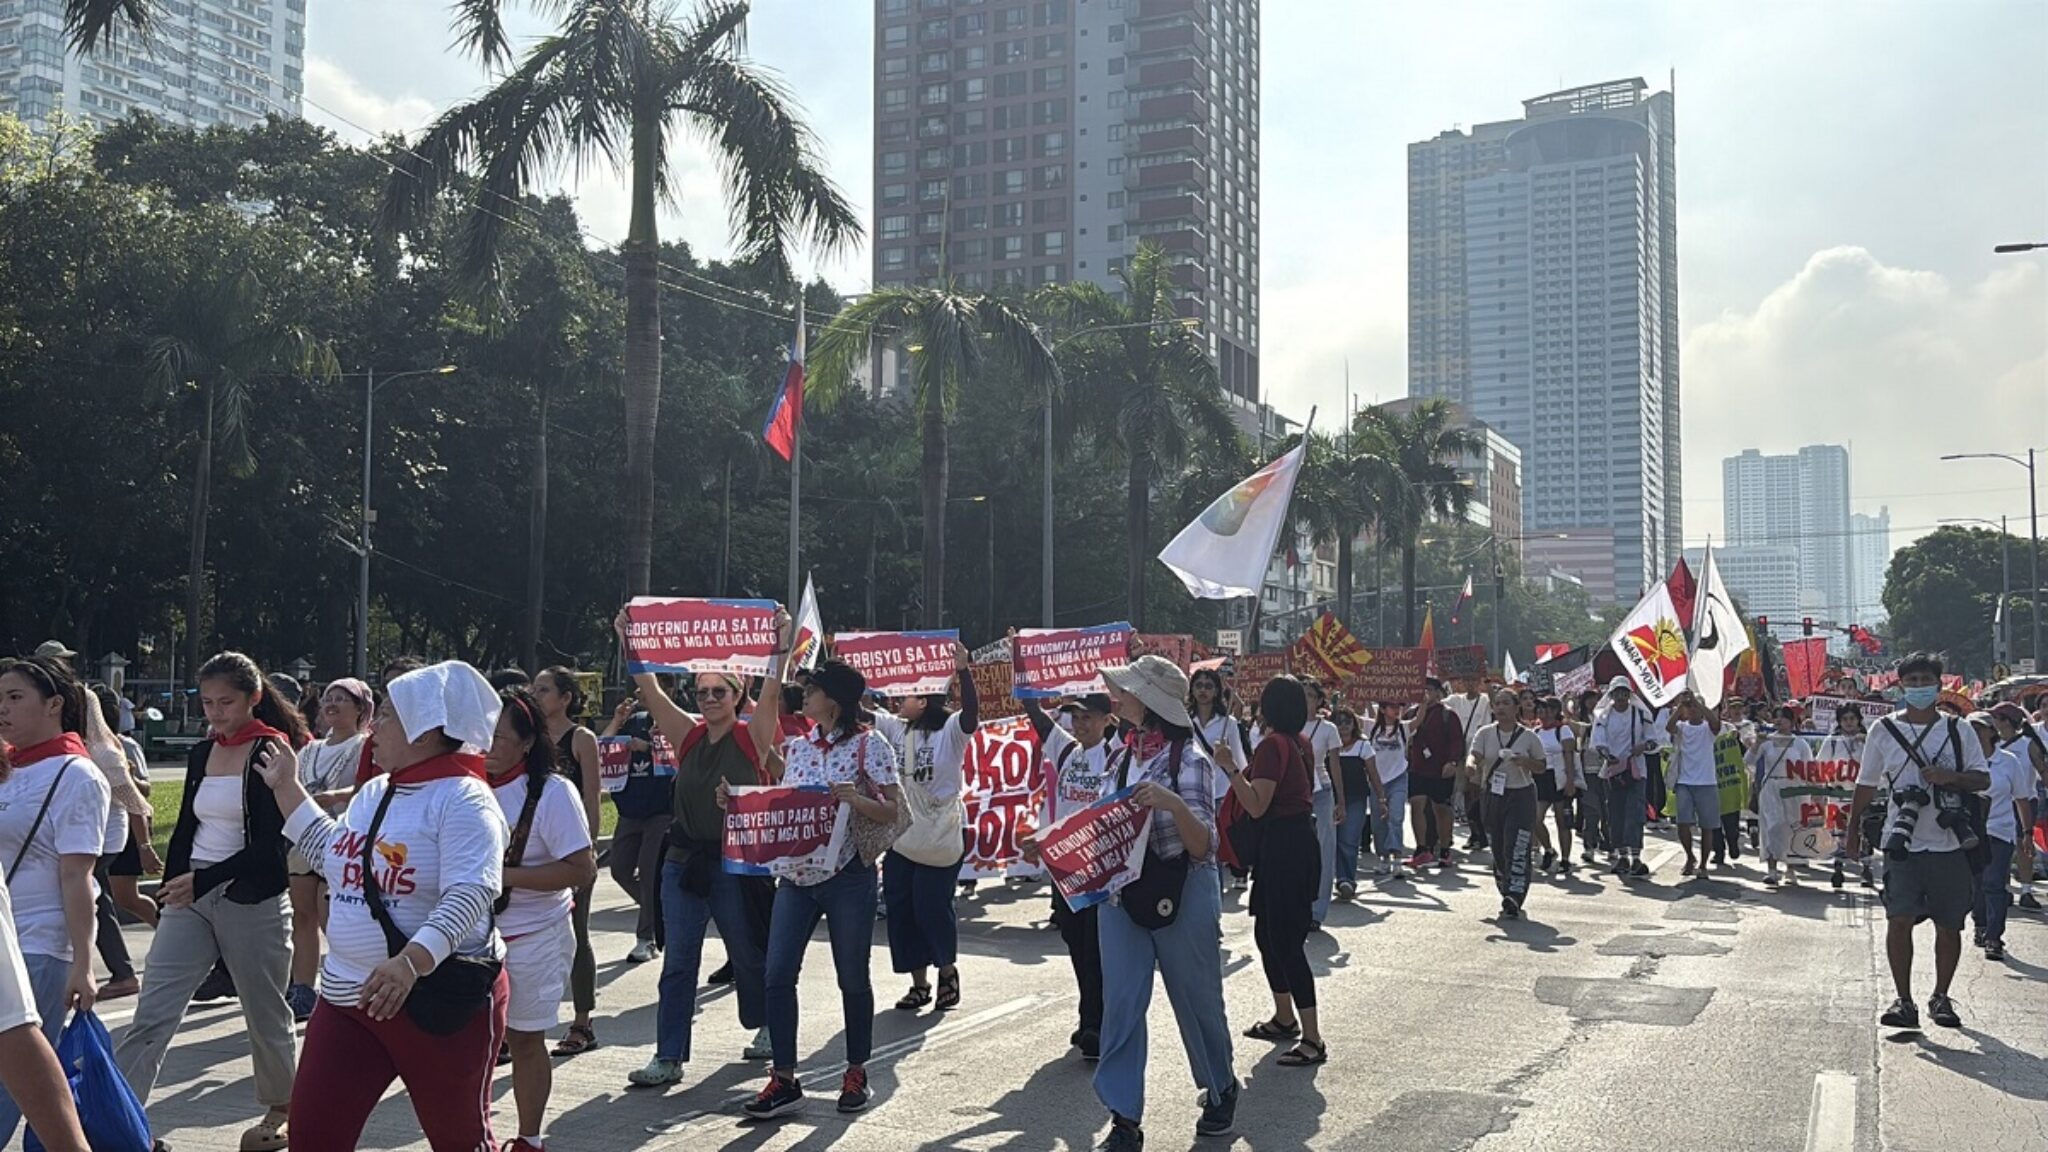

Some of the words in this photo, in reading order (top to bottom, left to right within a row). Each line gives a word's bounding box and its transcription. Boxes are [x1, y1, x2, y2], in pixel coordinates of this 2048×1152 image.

[626, 620, 689, 636] GOBYERNO
[693, 619, 727, 633] PARA
[732, 617, 750, 632] SA
[753, 616, 777, 631] TAO
[628, 635, 660, 650] HINDI
[664, 635, 681, 649] NG
[684, 634, 712, 648] MGA
[716, 632, 777, 647] OLIGARKO
[1020, 639, 1076, 657] EKONOMIYA
[1080, 634, 1106, 649] PARA
[1109, 631, 1122, 644] SA
[905, 646, 926, 663] SA
[1040, 647, 1100, 667] TAUMBAYAN
[875, 664, 914, 679] GAWING
[1015, 669, 1041, 685] HINDI
[1042, 667, 1057, 680] SA
[1058, 664, 1081, 679] MGA
[601, 763, 629, 776] WATAN
[1786, 758, 1860, 784] MARCO
[727, 809, 785, 829] GOBYERNO
[788, 808, 816, 823] PARA
[728, 829, 757, 846] HINDI
[760, 828, 775, 844] NG
[777, 827, 799, 843] MGA
[803, 821, 832, 839] OLIG
[1046, 819, 1105, 861] EKONOMIYA
[1101, 804, 1132, 828] PARA
[1128, 798, 1142, 813] S
[1075, 820, 1136, 863] TAUMBAYAN
[1060, 868, 1090, 894] HINDI
[1086, 861, 1104, 879] SA
